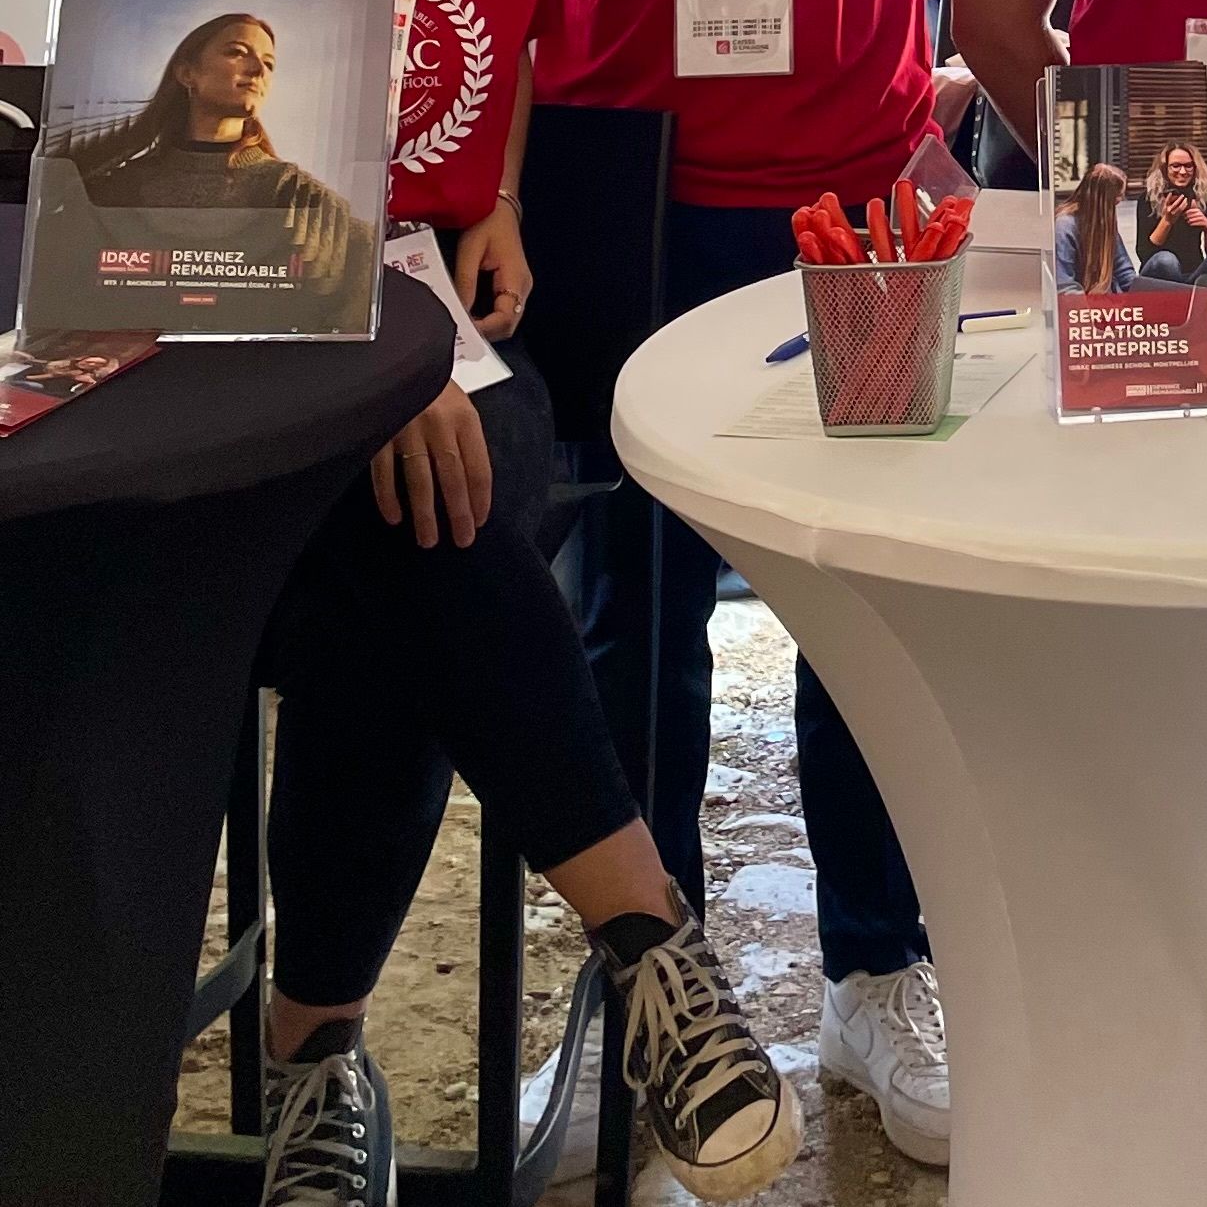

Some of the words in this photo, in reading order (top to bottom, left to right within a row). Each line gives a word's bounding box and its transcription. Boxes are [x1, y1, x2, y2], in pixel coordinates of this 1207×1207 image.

[101, 250, 151, 266] IDRAC
[172, 250, 244, 263] DEVENEZ
[170, 264, 288, 277] REMARQUABLE
[1069, 307, 1143, 324] SERVICE
[1069, 323, 1169, 341] RELATIONS
[1069, 340, 1189, 358] ENTREPRISES
